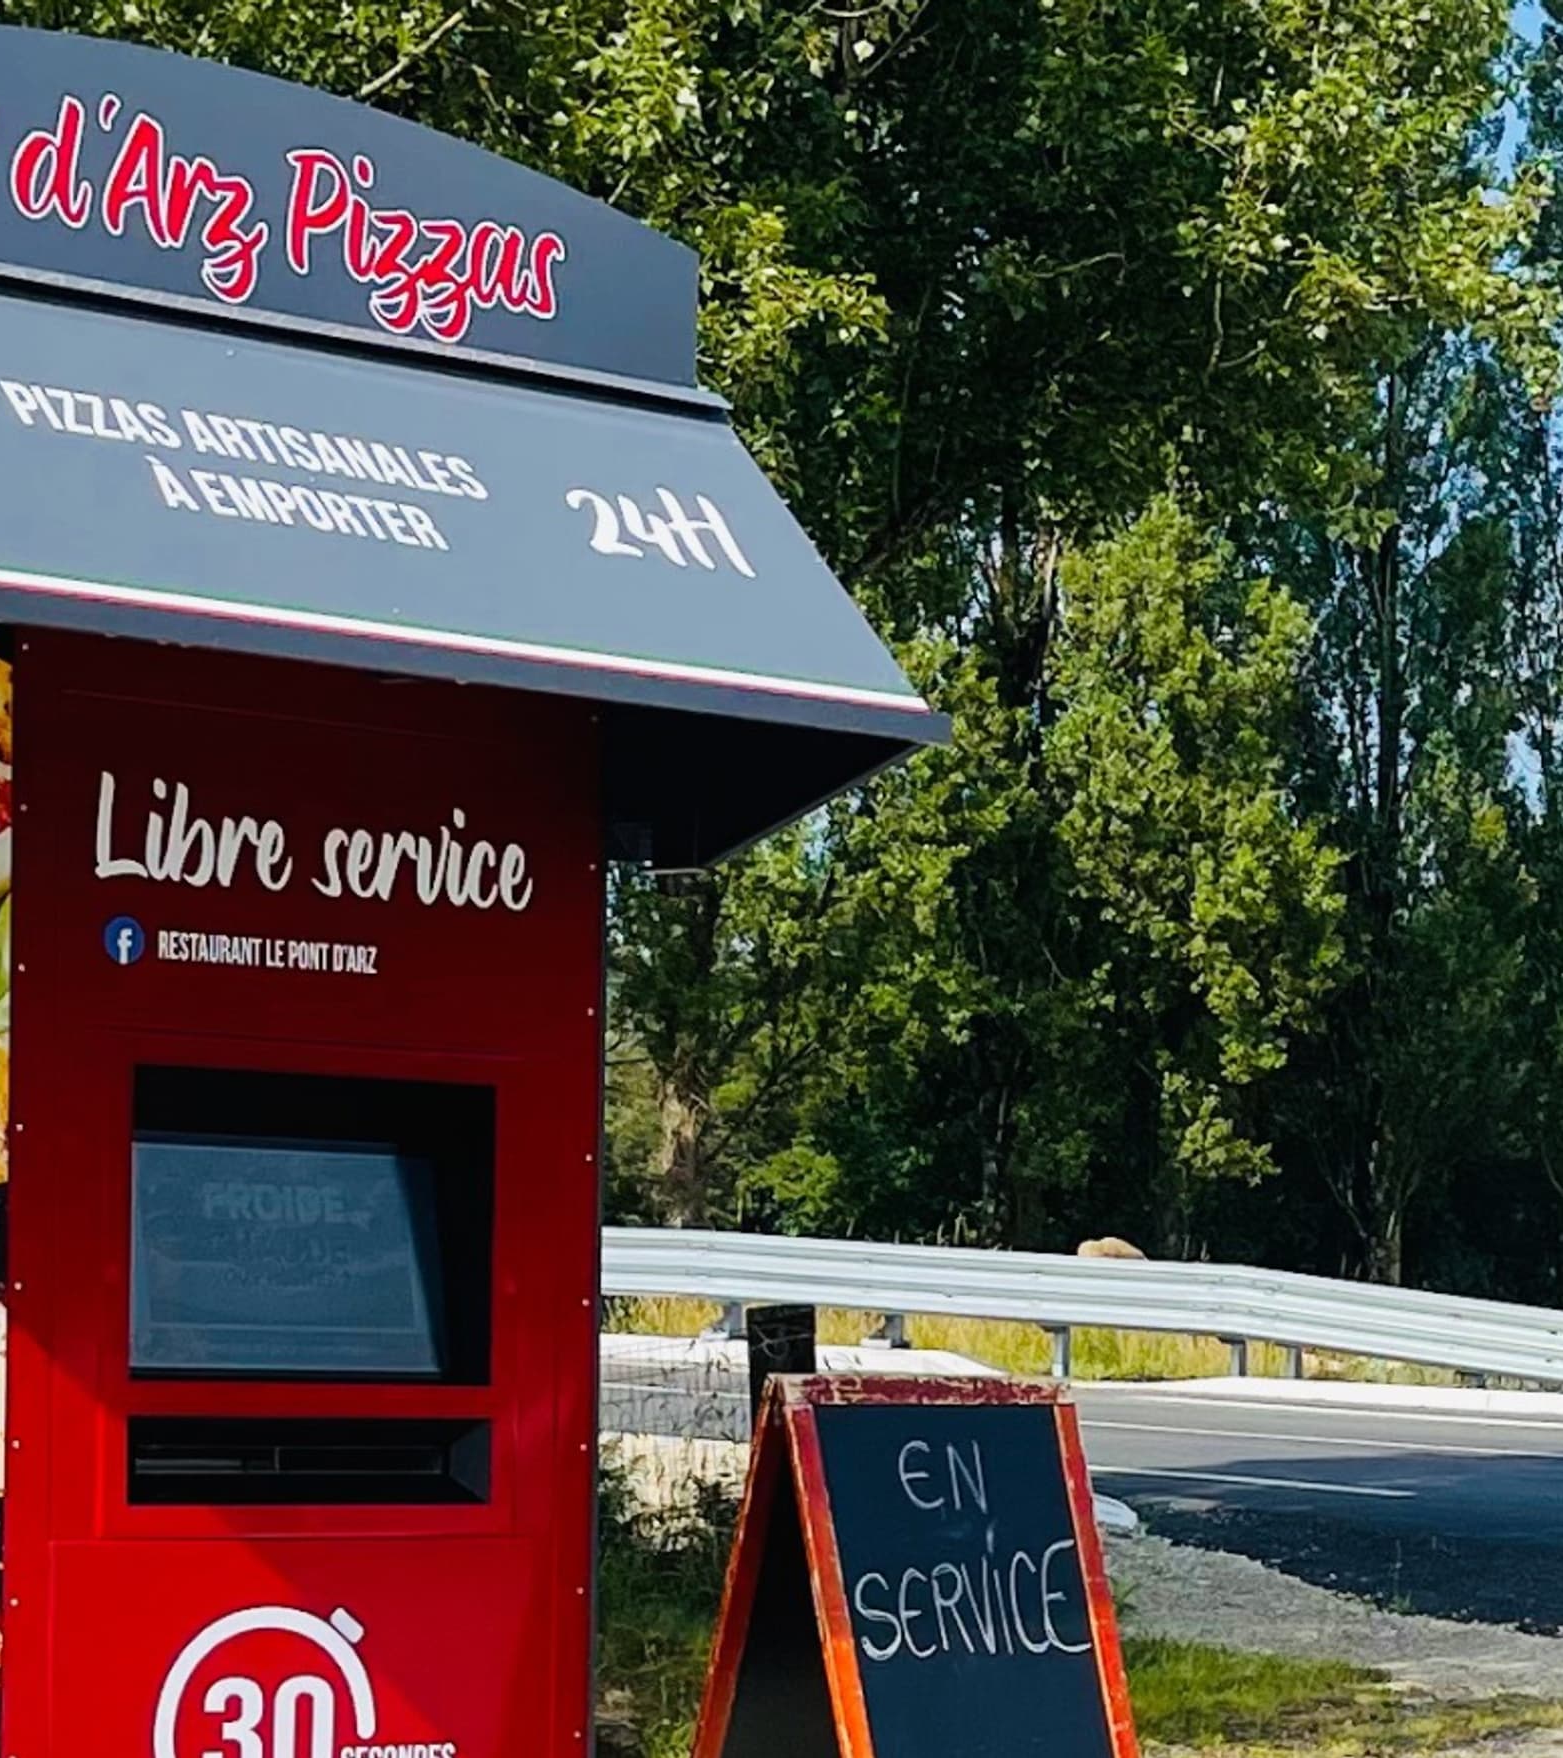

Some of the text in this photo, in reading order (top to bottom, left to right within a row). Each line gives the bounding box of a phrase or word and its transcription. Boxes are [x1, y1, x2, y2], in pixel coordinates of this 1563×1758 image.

[11, 94, 268, 303] d'Arz
[285, 147, 568, 344] Pizzas
[0, 379, 489, 500] PIZZAS ARTISANALES
[145, 454, 450, 551] À EMPORTER
[565, 487, 757, 578] 24H
[95, 771, 534, 911] Libre service
[158, 929, 263, 967] RESTAURANT
[265, 938, 285, 968] LE
[288, 940, 329, 971] PONT
[333, 944, 378, 974] D'ARZ
[897, 1440, 987, 1514] EN
[202, 1675, 335, 1758] 30
